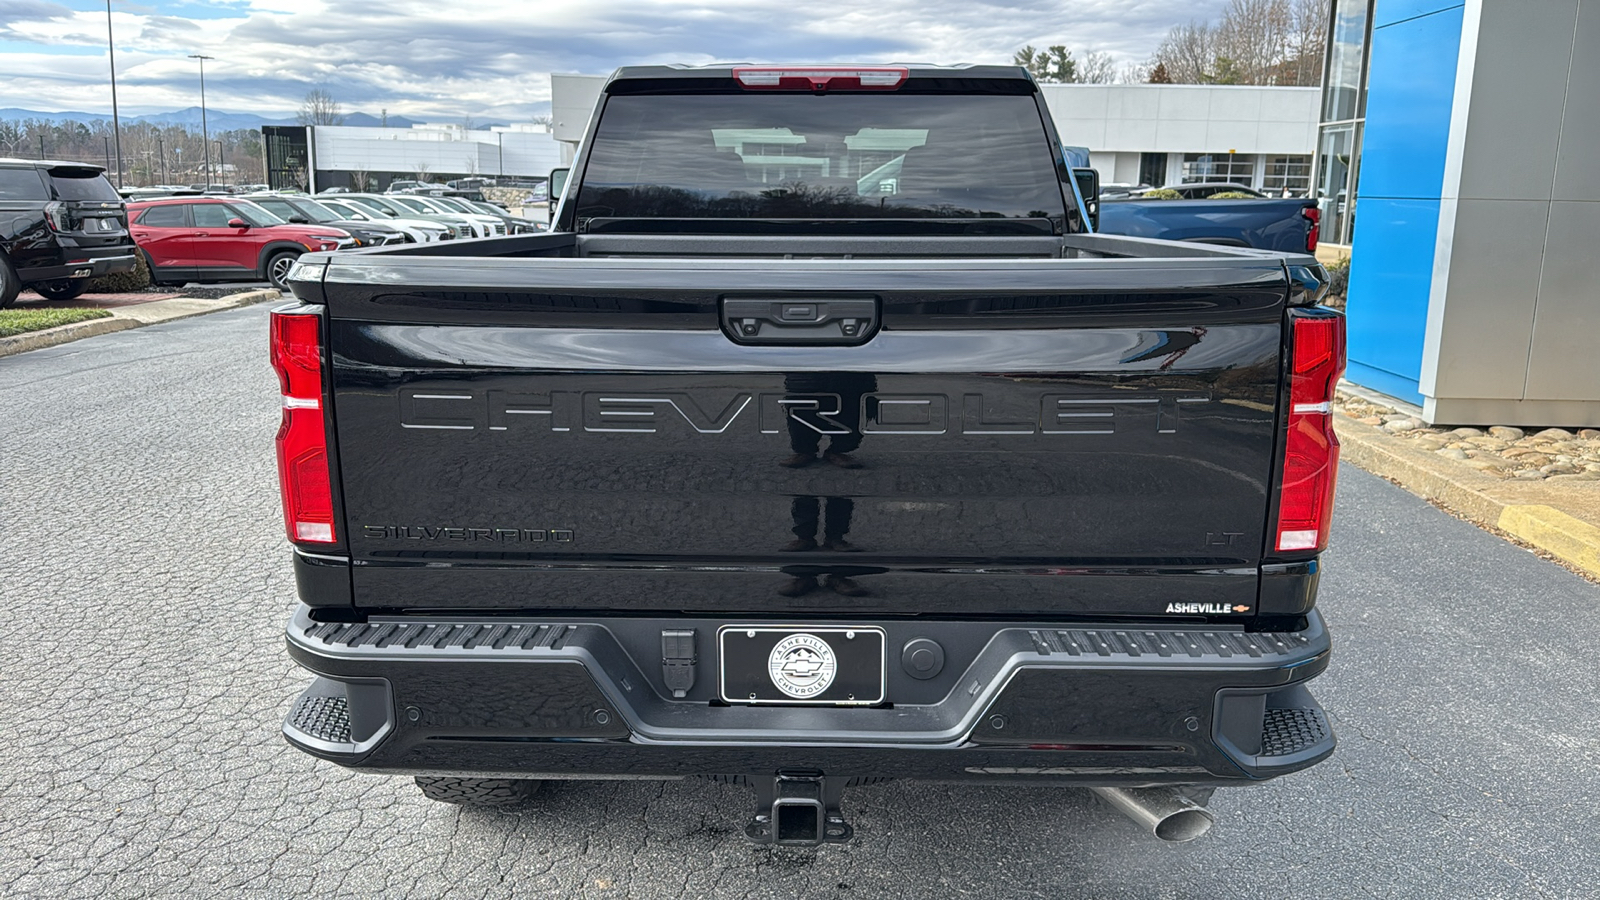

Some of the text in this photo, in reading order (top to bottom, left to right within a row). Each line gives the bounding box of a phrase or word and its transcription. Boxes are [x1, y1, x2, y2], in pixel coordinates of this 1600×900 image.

[398, 387, 1212, 435] CHEVROLET
[364, 525, 575, 542] SILVERADO
[1205, 532, 1244, 545] LT
[1165, 602, 1232, 614] ASHEVILLE
[777, 638, 829, 656] ASHEVILLE
[778, 677, 828, 694] CHEVROLET
